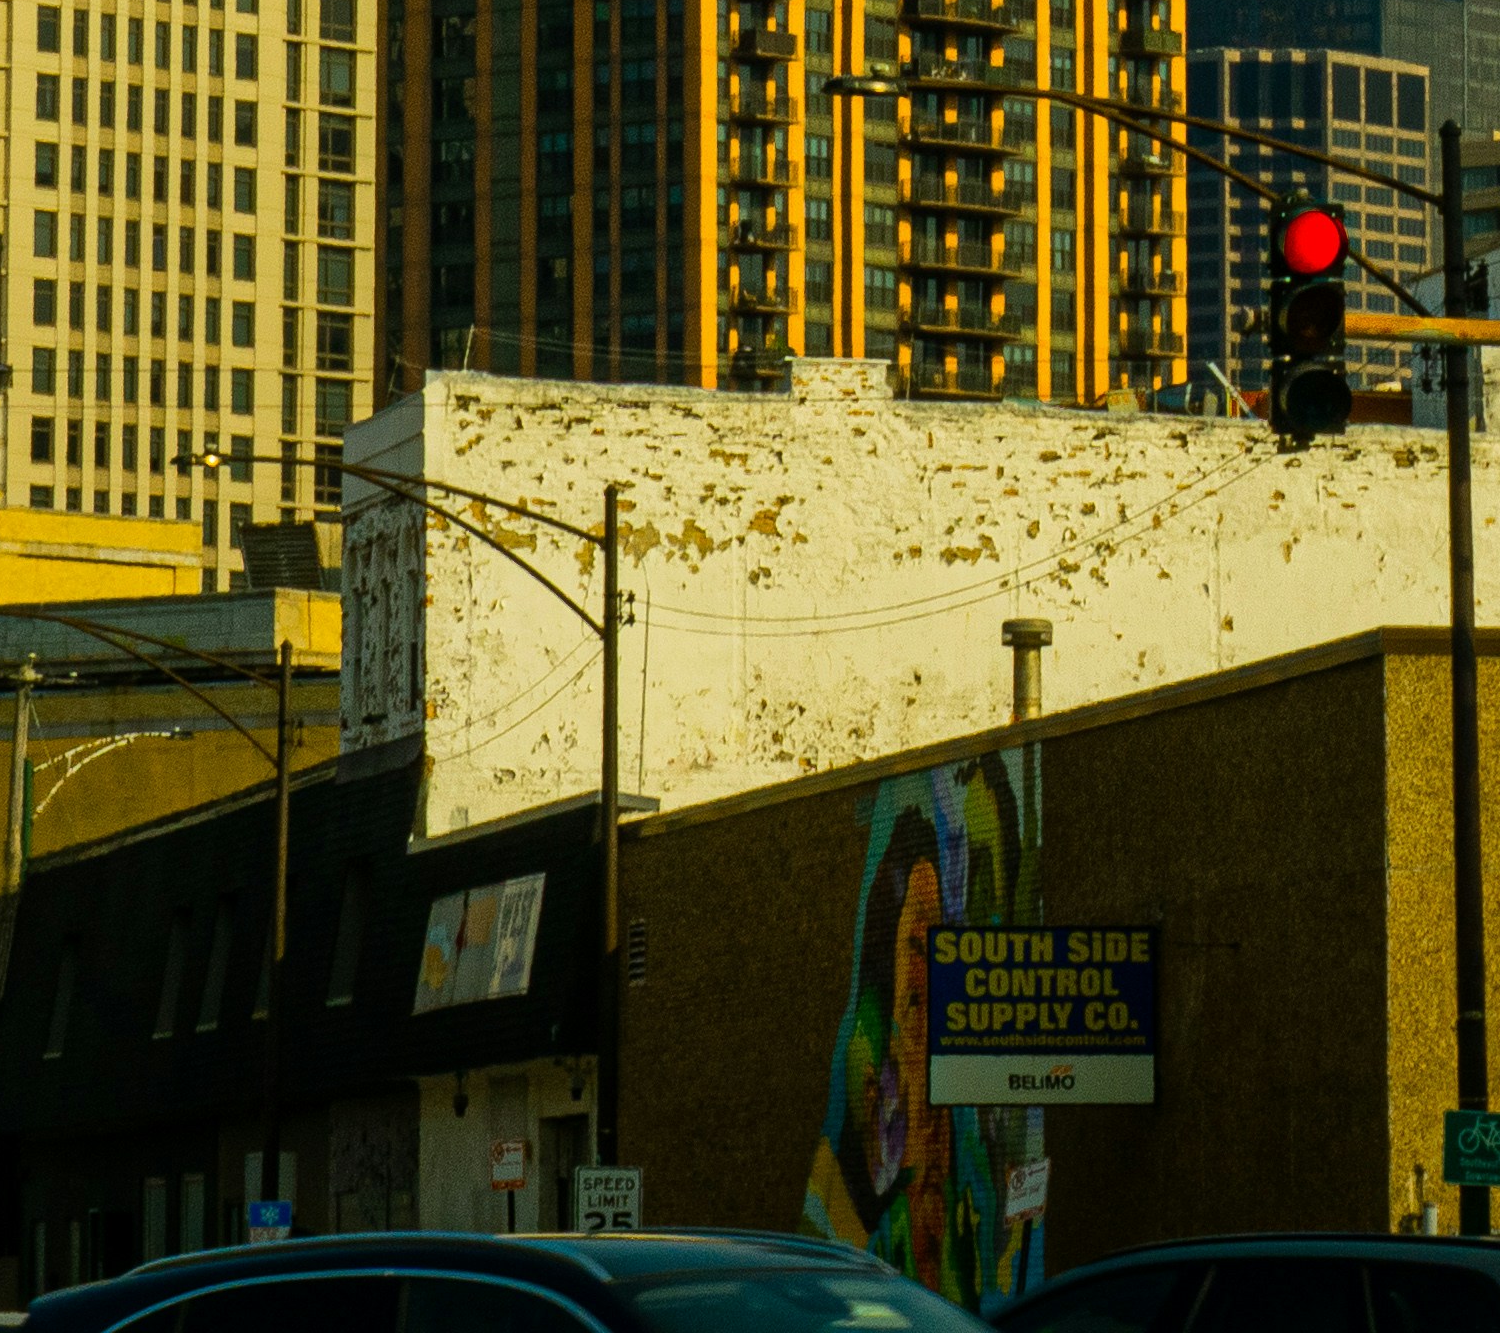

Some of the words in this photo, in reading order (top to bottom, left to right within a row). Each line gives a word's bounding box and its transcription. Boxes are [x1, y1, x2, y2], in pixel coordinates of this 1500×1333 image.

[934, 931, 1054, 964] SOUTH
[964, 967, 1120, 998] CONTROL
[945, 1000, 1073, 1033] SUPPLY
[1083, 1000, 1140, 1032] CO.
[583, 1176, 635, 1191] SPEED
[588, 1194, 628, 1208] LIMIT
